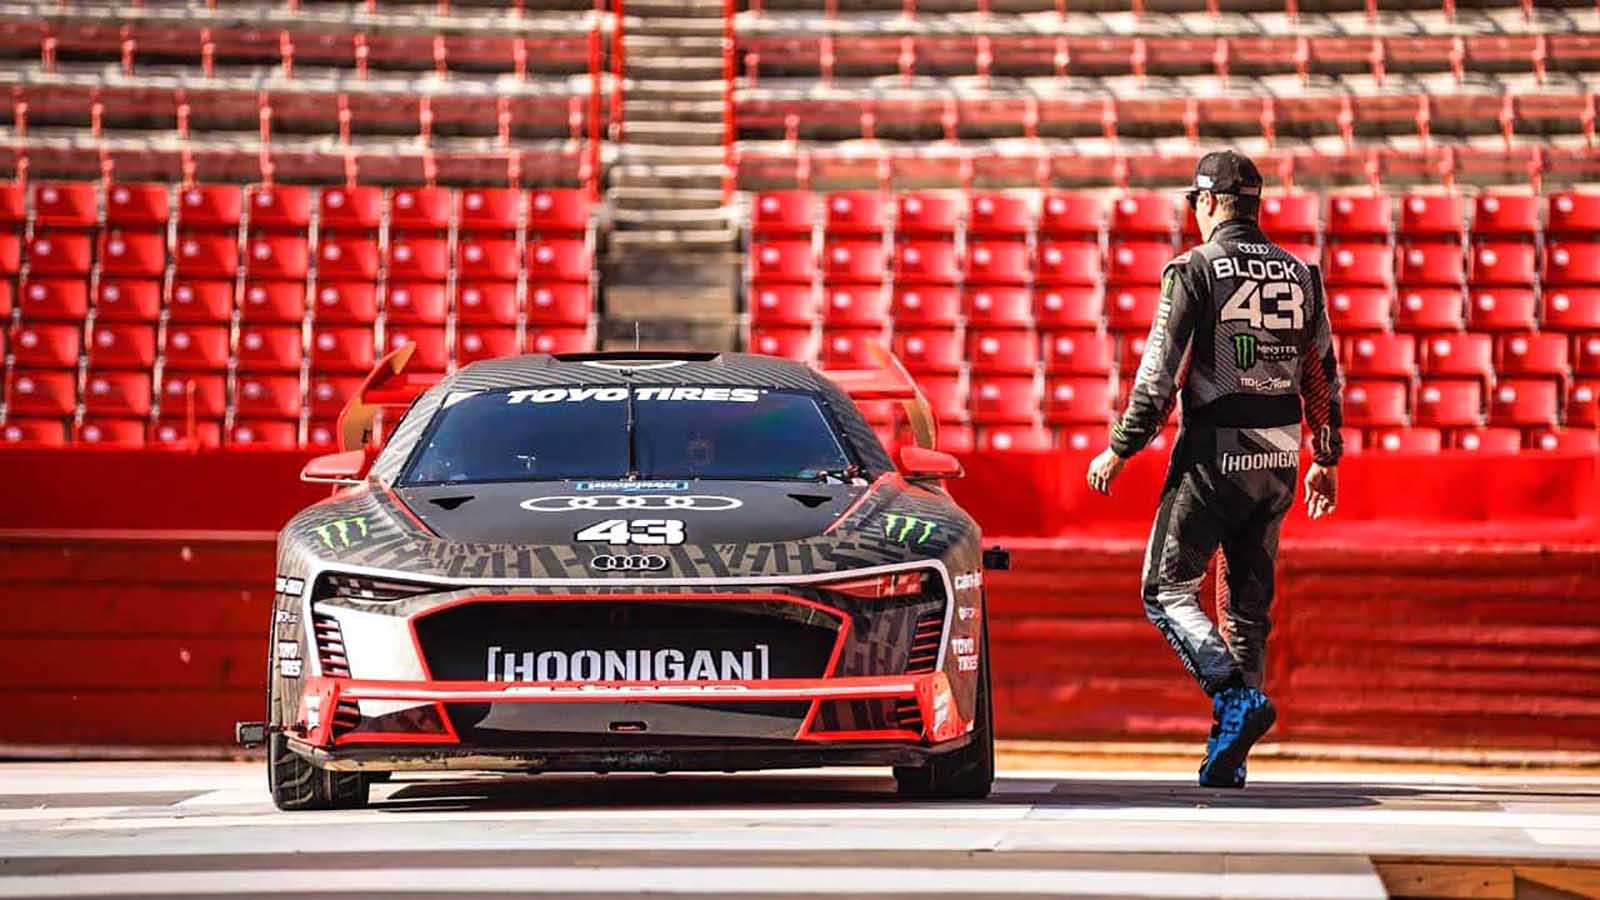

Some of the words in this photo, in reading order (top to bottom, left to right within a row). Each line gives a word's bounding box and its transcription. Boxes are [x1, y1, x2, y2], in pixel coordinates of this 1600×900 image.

[1212, 257, 1299, 281] BLOCK
[1220, 280, 1304, 330] 43
[507, 388, 627, 404] TOYO
[634, 388, 760, 402] TIRES
[576, 519, 686, 545] 43
[487, 645, 769, 682] [HOONIGAN]
